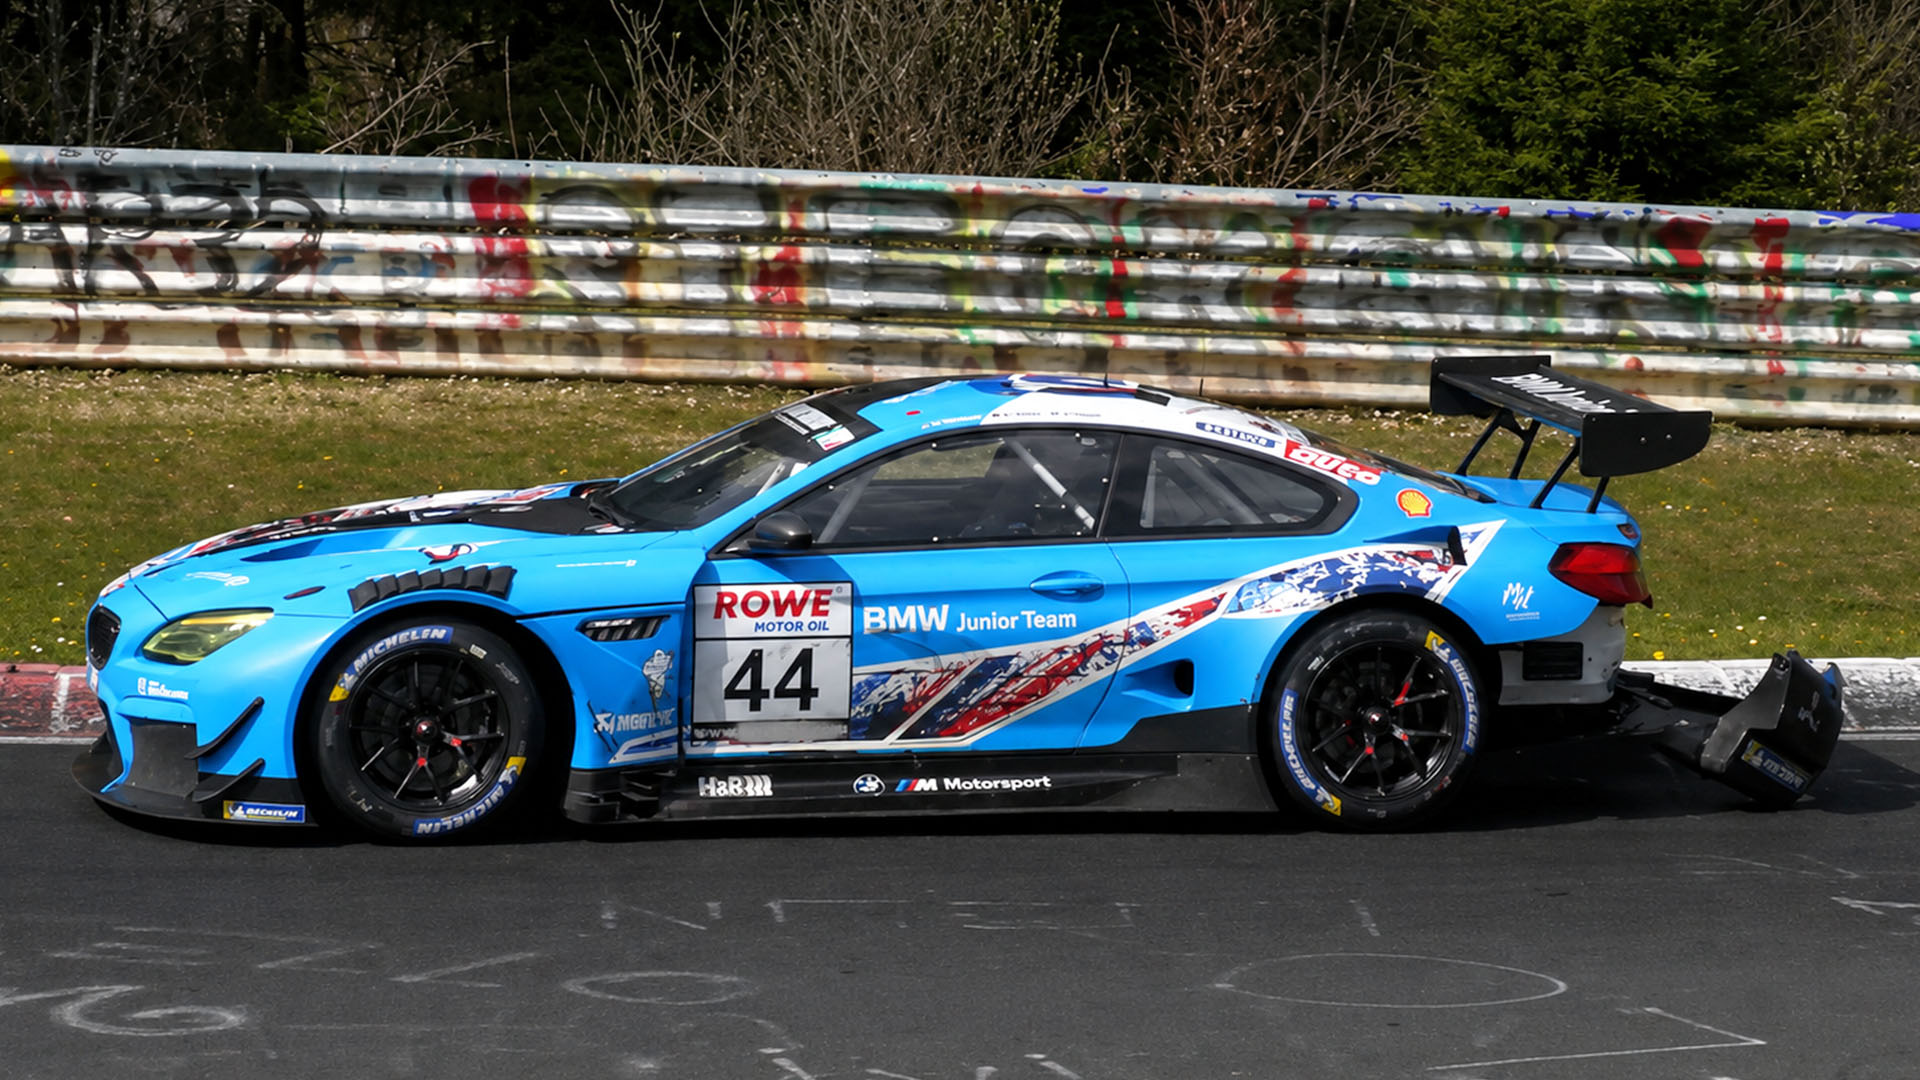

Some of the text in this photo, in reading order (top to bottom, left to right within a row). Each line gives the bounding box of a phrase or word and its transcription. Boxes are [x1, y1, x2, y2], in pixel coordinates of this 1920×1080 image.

[713, 589, 833, 619] ROWE
[863, 604, 1077, 634] BMW Junior Team
[754, 621, 829, 632] MOTOR OIL
[724, 648, 819, 711] 44
[943, 775, 1052, 791] Motorsport
